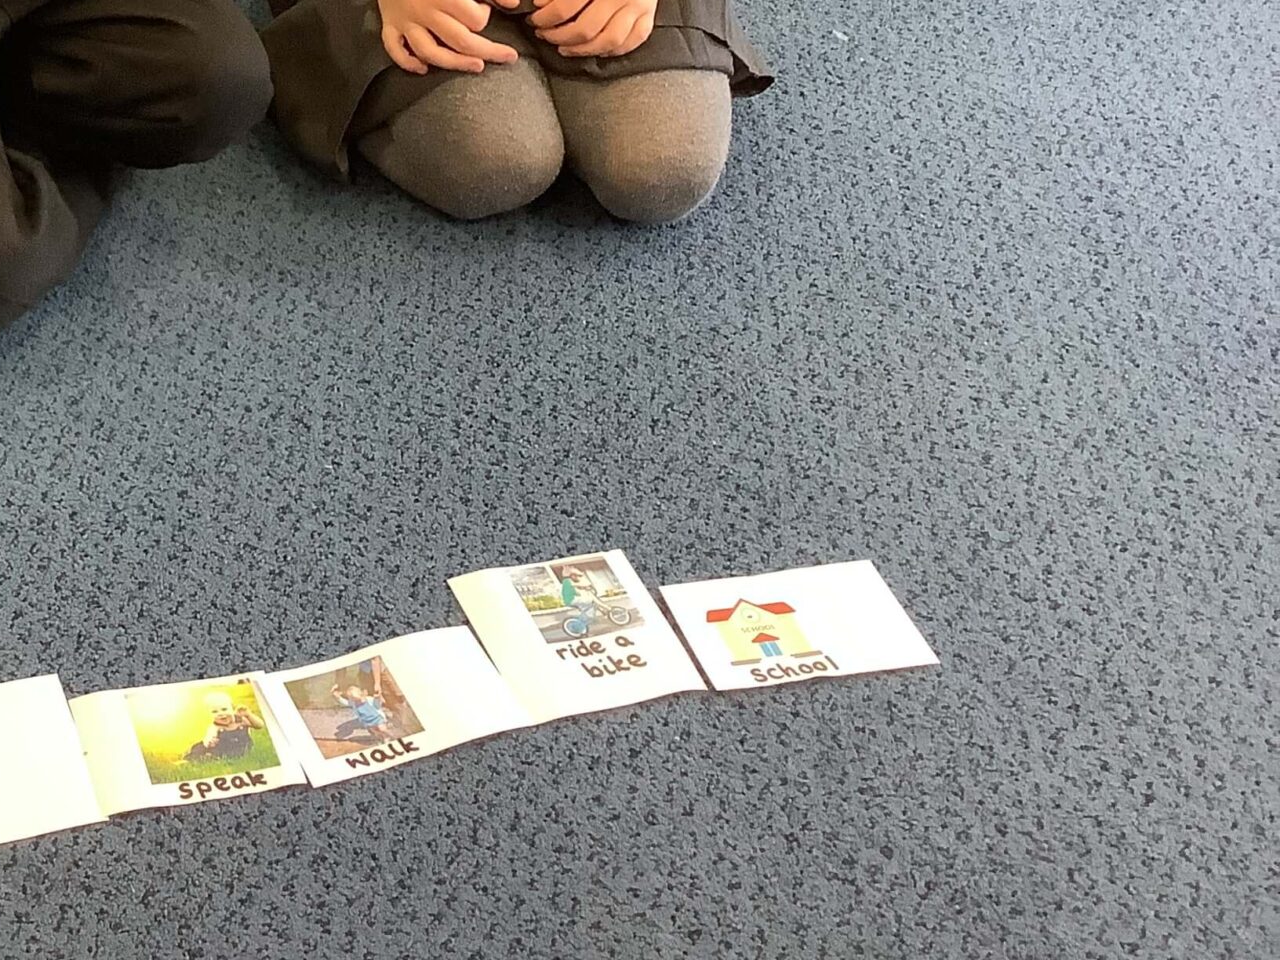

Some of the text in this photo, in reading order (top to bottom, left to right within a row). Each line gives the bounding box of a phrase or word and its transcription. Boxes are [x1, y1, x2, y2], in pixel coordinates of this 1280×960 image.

[556, 636, 635, 661] ride a
[581, 652, 649, 679] bike
[345, 738, 421, 770] walk
[178, 770, 268, 800] speak
